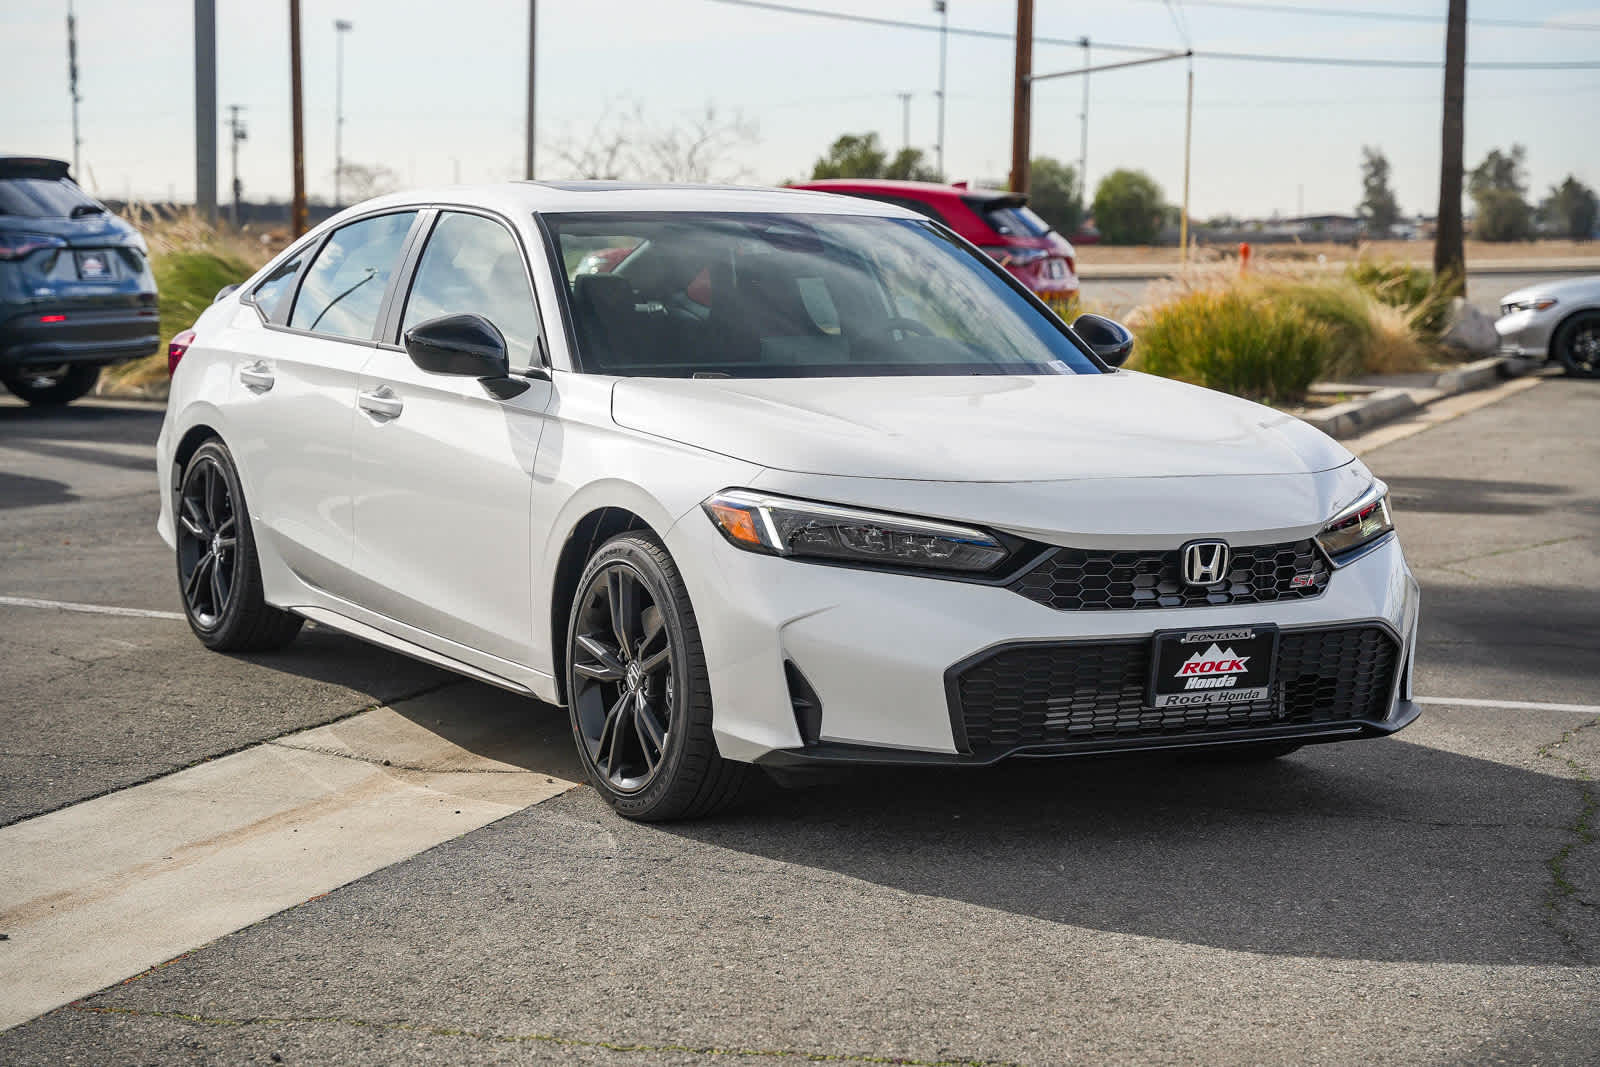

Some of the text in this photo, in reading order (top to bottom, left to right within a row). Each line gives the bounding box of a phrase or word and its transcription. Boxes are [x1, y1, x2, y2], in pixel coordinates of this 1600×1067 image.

[1190, 632, 1248, 641] FONTANA
[1182, 660, 1243, 674] ROCK
[1184, 675, 1237, 689] Honda
[1165, 690, 1260, 705] Rock Honda
